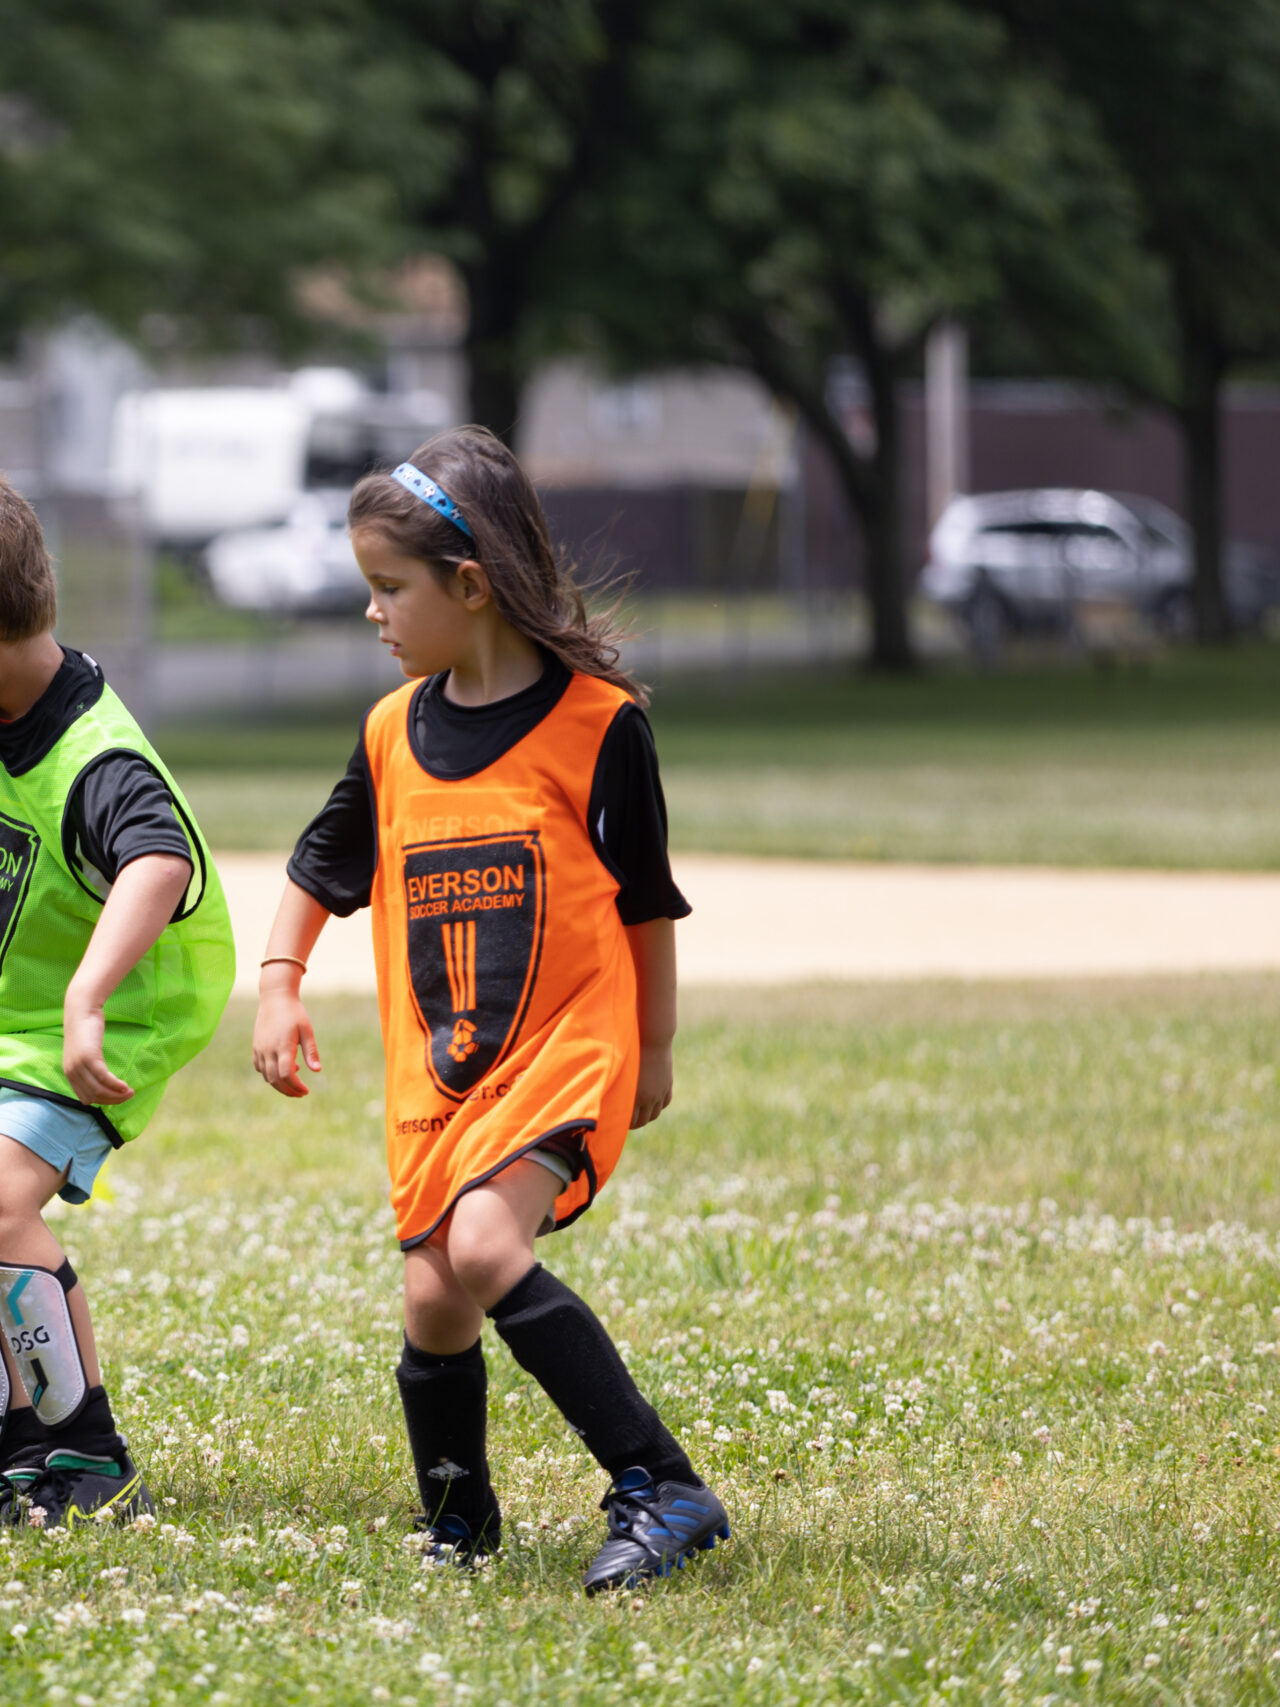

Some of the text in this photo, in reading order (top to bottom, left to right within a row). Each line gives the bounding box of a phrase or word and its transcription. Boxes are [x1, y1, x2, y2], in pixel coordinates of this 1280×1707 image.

[407, 865, 524, 903] EVERSON
[409, 893, 525, 920] SOCCER ACADEMY
[11, 1325, 50, 1354] DSG
